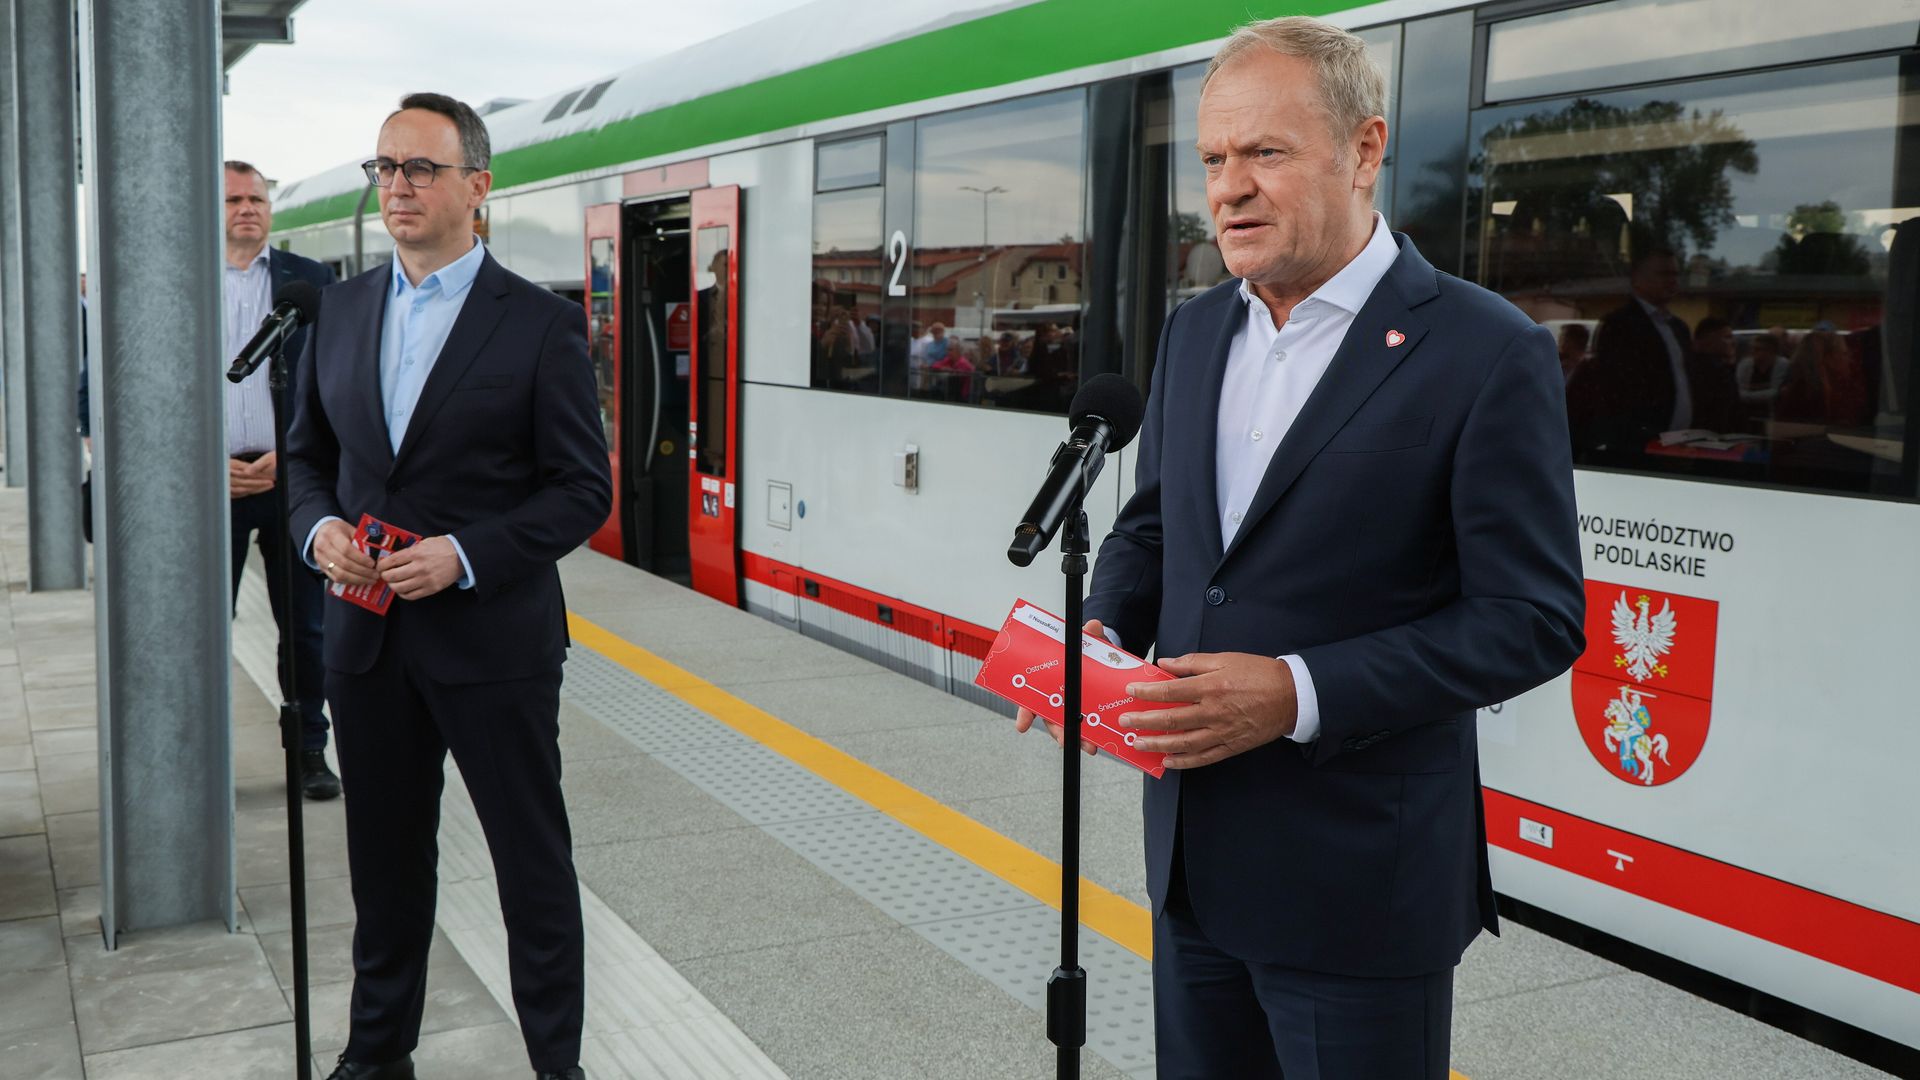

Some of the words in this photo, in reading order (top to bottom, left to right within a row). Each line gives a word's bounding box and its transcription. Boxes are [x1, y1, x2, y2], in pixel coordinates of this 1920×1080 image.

[888, 230, 907, 296] 2
[1578, 514, 1733, 552] WOJEWÓDZTWO
[1594, 543, 1706, 577] PODLASKIE
[1098, 696, 1134, 711] Śniadowo
